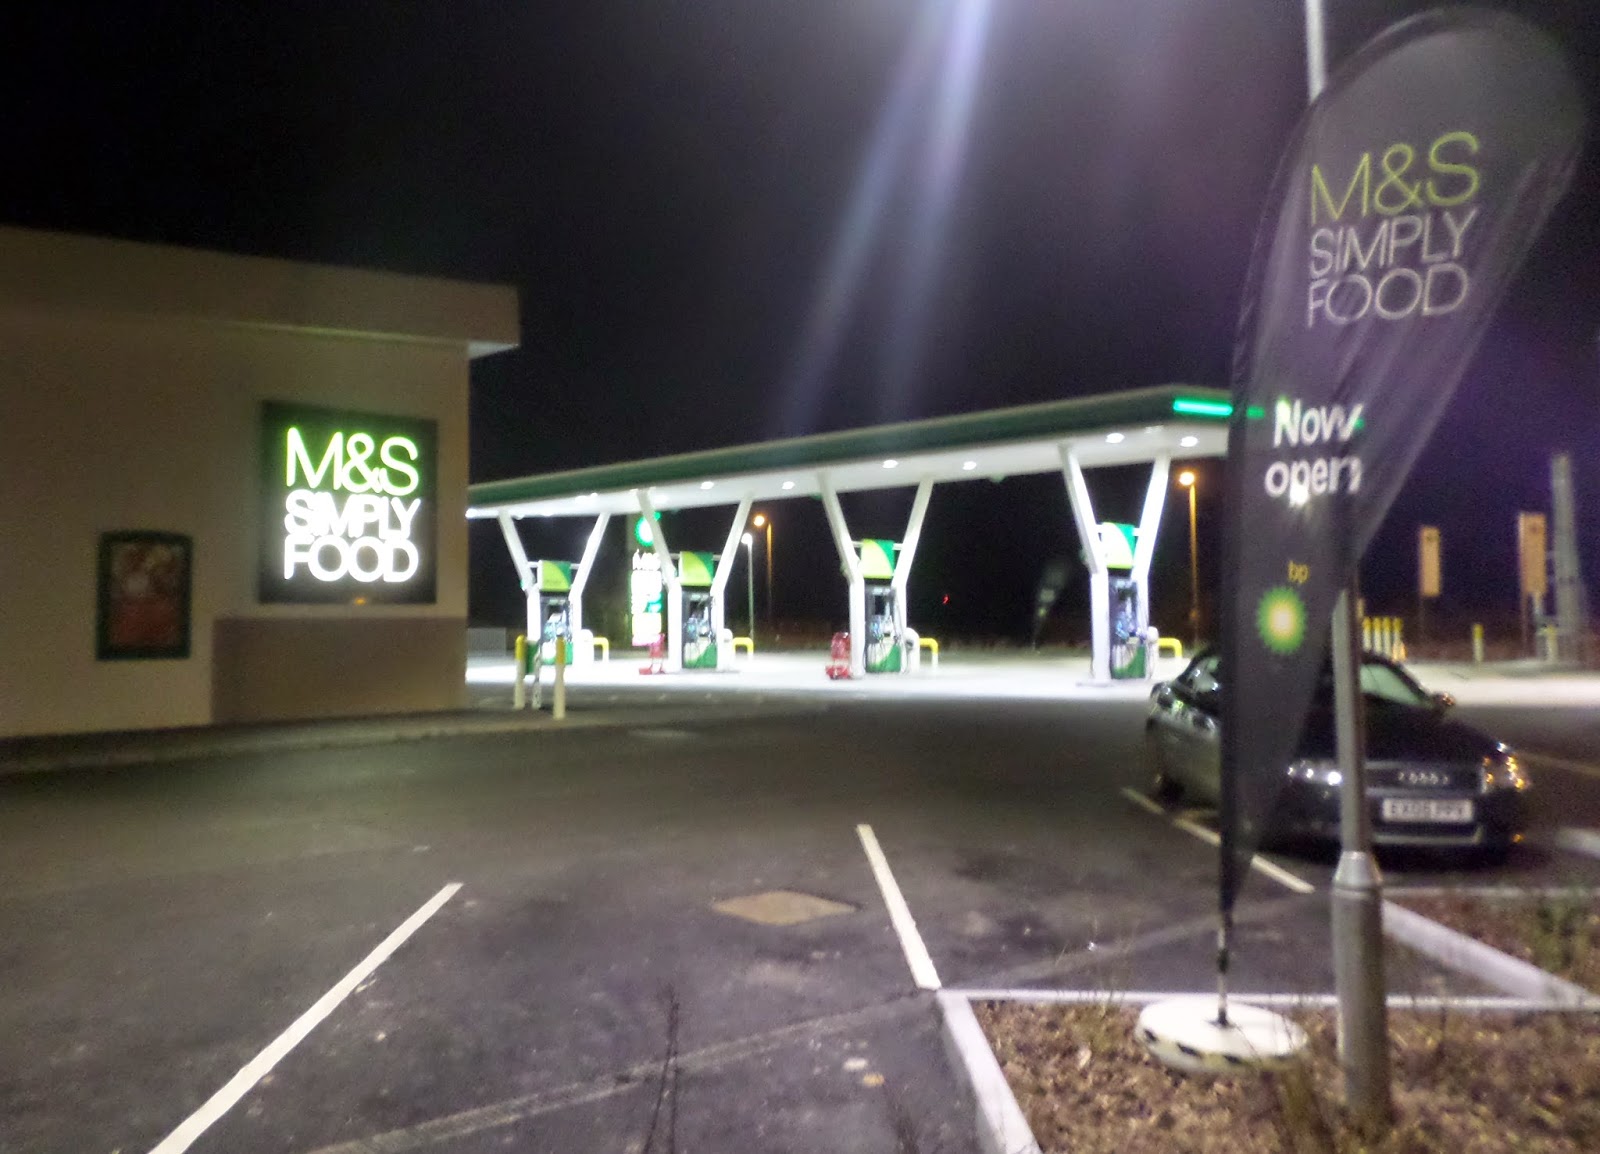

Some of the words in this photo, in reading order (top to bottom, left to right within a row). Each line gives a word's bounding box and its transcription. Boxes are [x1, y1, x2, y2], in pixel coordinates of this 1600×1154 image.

[1311, 131, 1480, 224] M&S
[1311, 207, 1477, 278] SIMPLY
[1308, 262, 1469, 328] FOOD
[1274, 398, 1363, 447] Now
[286, 427, 420, 496] M&S
[1264, 456, 1362, 508] open
[284, 489, 421, 540] SIMPLY
[283, 536, 420, 582] FOOD
[1287, 561, 1310, 584] bp
